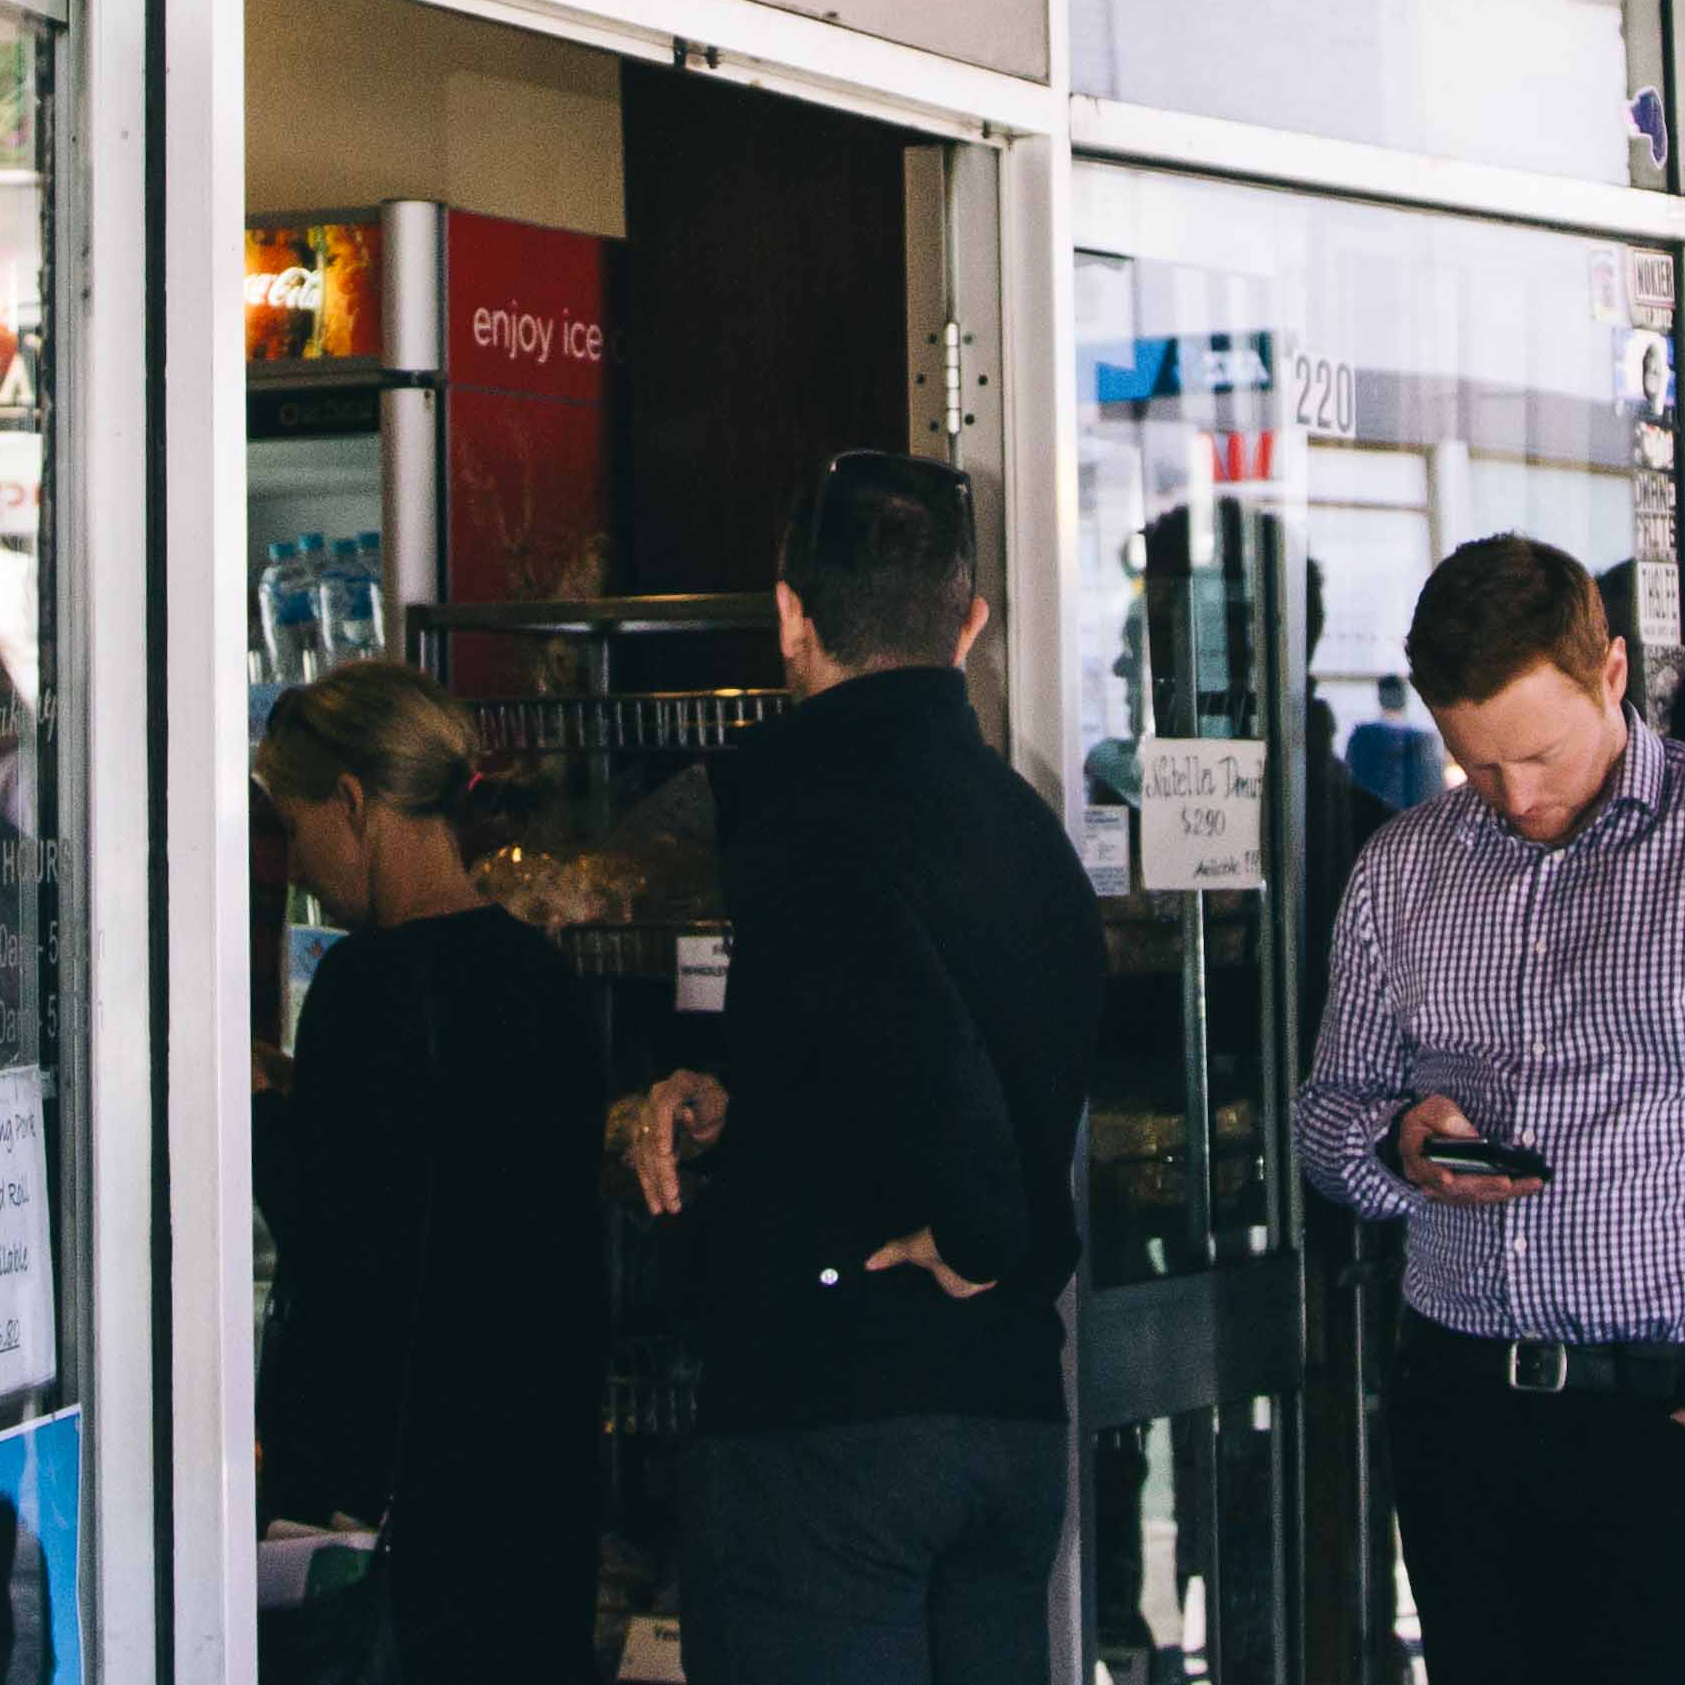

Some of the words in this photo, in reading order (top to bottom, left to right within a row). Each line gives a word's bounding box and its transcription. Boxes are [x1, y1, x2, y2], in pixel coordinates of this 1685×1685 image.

[472, 300, 555, 363] enjoy
[562, 308, 604, 362] ice
[1294, 353, 1355, 435] 220
